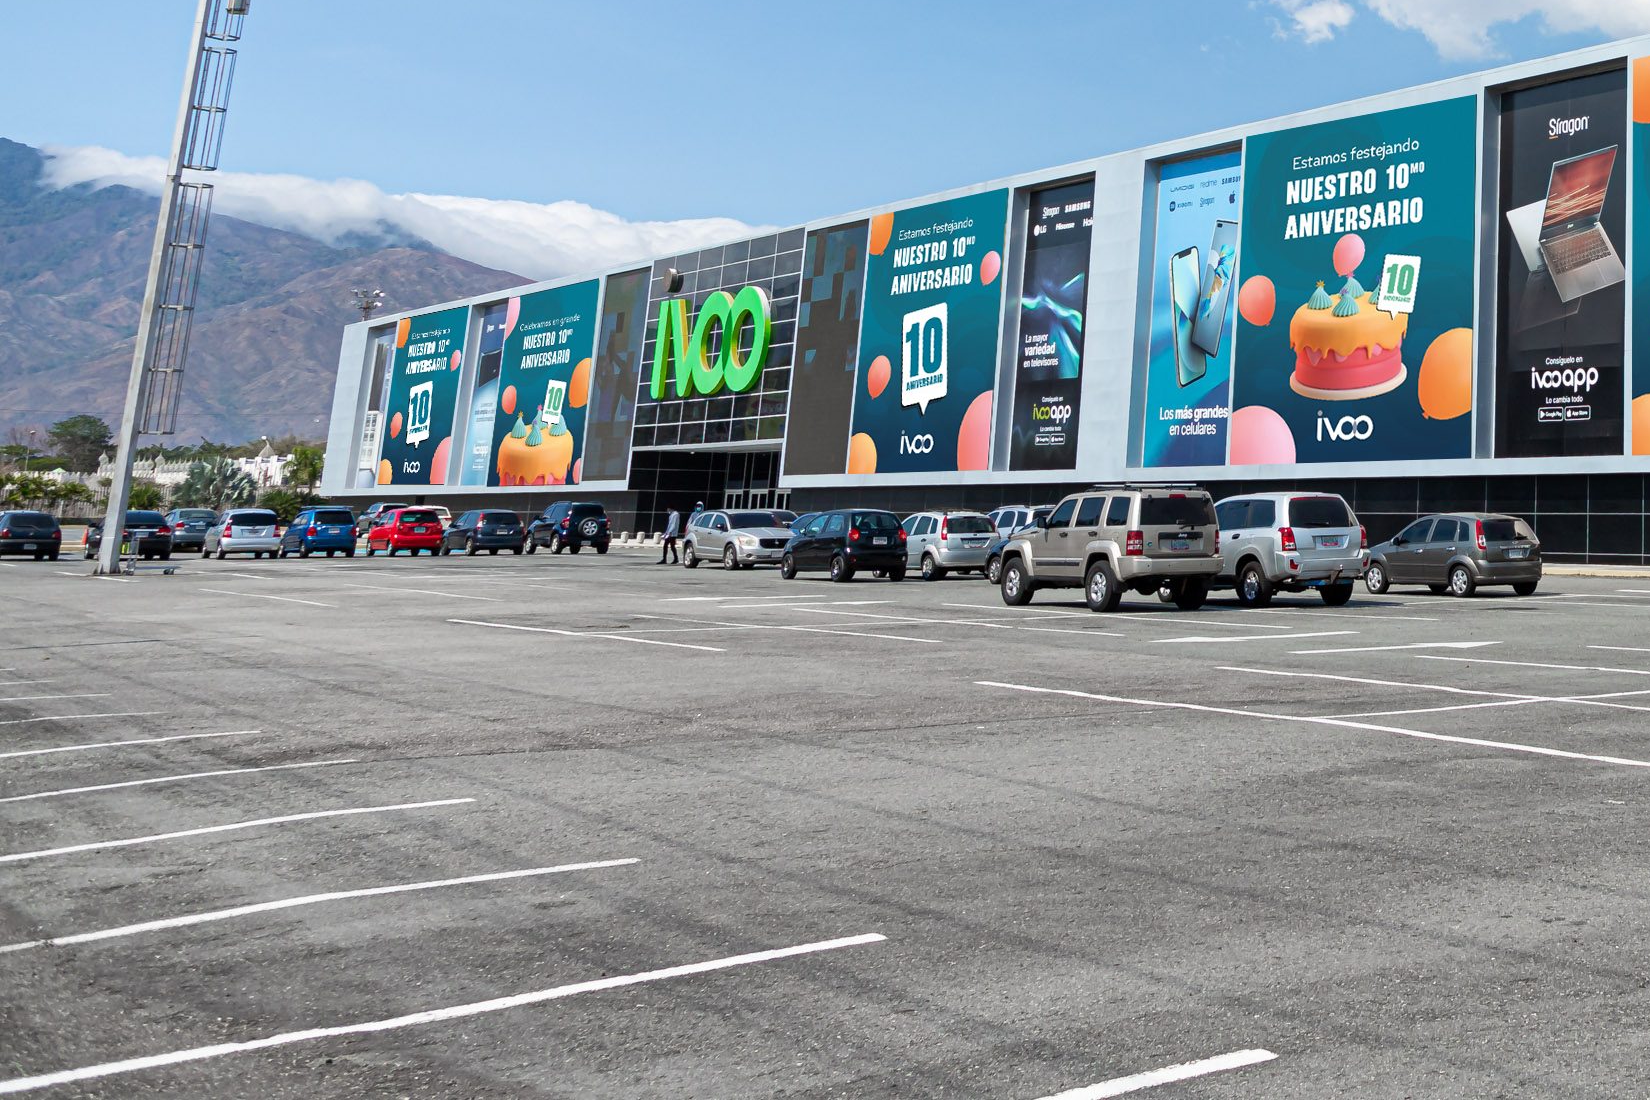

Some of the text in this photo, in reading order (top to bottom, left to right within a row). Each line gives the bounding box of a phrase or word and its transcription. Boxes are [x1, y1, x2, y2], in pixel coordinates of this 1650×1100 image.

[1293, 138, 1420, 170] Estamos festejando
[1200, 180, 1217, 188] realme
[1286, 168, 1376, 206] NUESTRO
[1065, 201, 1091, 213] SAMSUNG
[1284, 196, 1424, 240] ANIVERSARIO
[899, 217, 973, 240] Estamos festejando
[893, 240, 947, 268] NUESTRO
[890, 263, 973, 296] ANIVERSARIO
[1387, 263, 1414, 296] 10
[523, 331, 556, 350] NUESTRO
[906, 317, 943, 378] 10
[1025, 333, 1048, 344] La mayor
[1025, 342, 1055, 356] variedad
[520, 349, 571, 370] ANIVERSARIO
[1024, 357, 1058, 368] en televisores
[1545, 356, 1575, 366] Consíguelo
[906, 374, 943, 391] ANIVERSARIO
[410, 389, 430, 427] 10
[547, 386, 563, 411] 10
[1160, 405, 1228, 422] Los más grandes
[1169, 422, 1216, 435] en celulares
[1317, 410, 1373, 442] ivoo
[900, 430, 934, 455] ivoo
